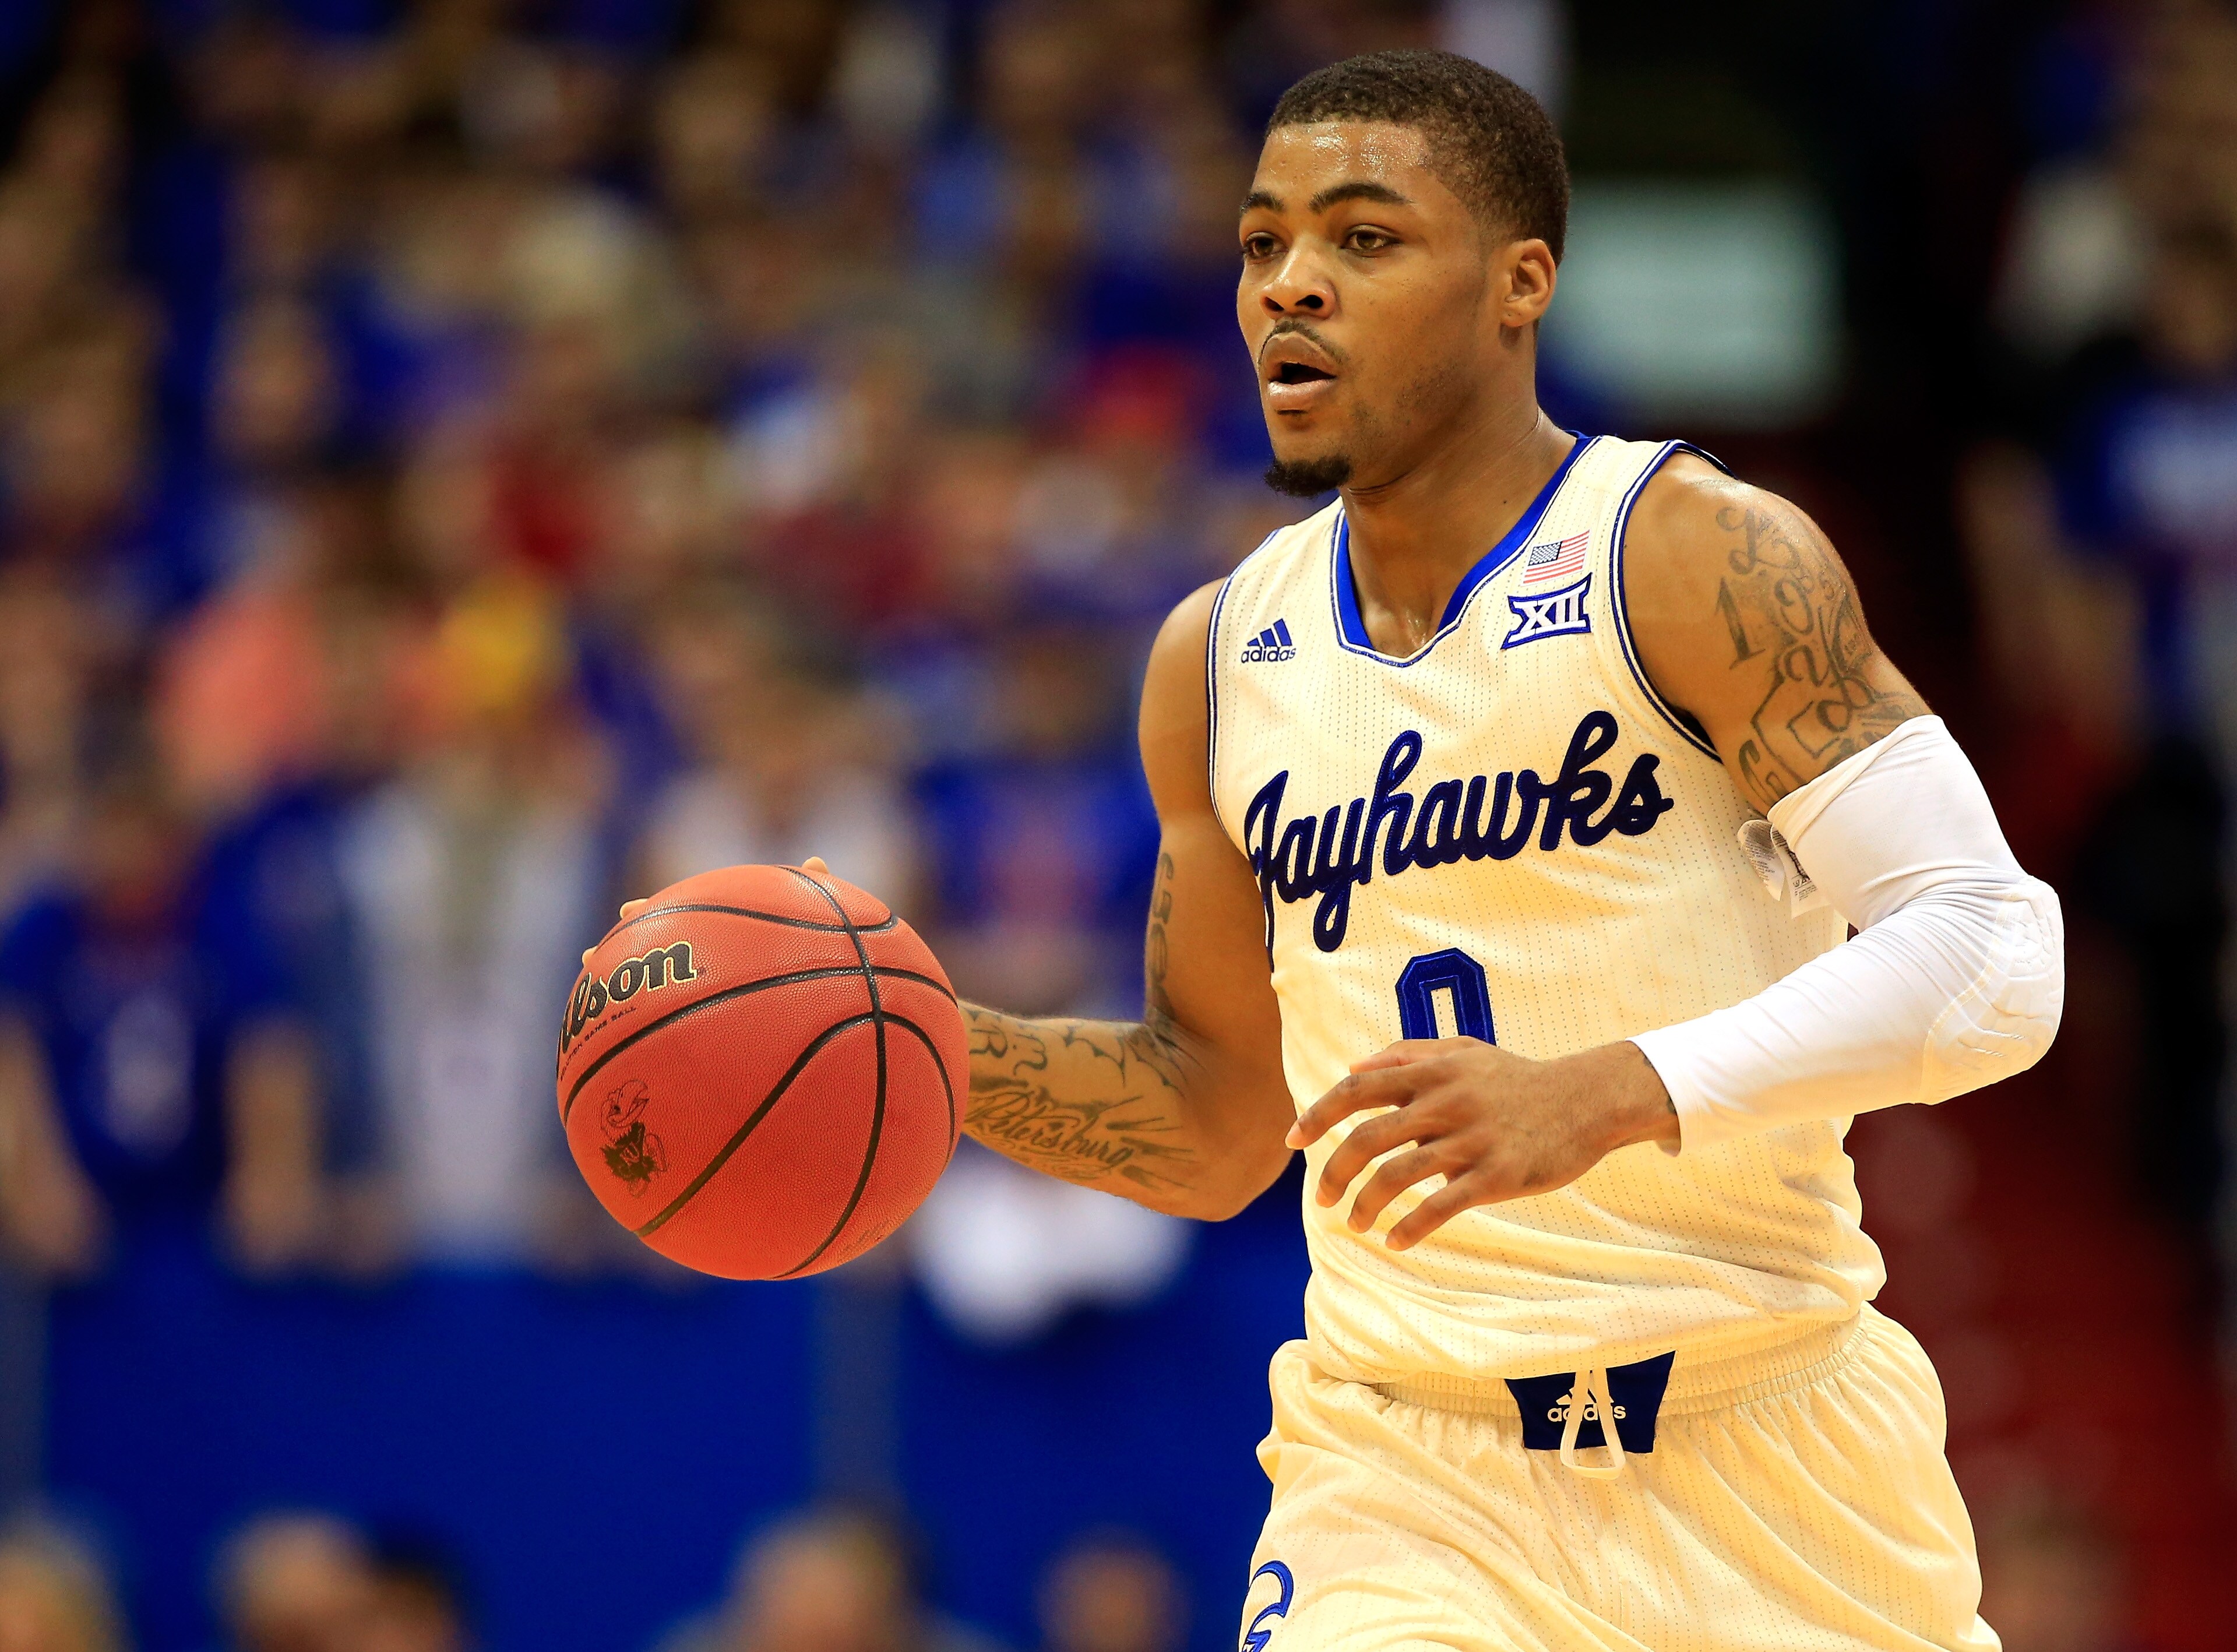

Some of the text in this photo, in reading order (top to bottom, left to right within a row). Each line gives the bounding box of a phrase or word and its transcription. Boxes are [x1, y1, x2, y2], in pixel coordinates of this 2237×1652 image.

[1241, 645, 1297, 664] adidas
[1243, 710, 1674, 967] Jayhawks
[556, 941, 698, 1054] ilson
[1547, 1404, 1627, 1422] ads
